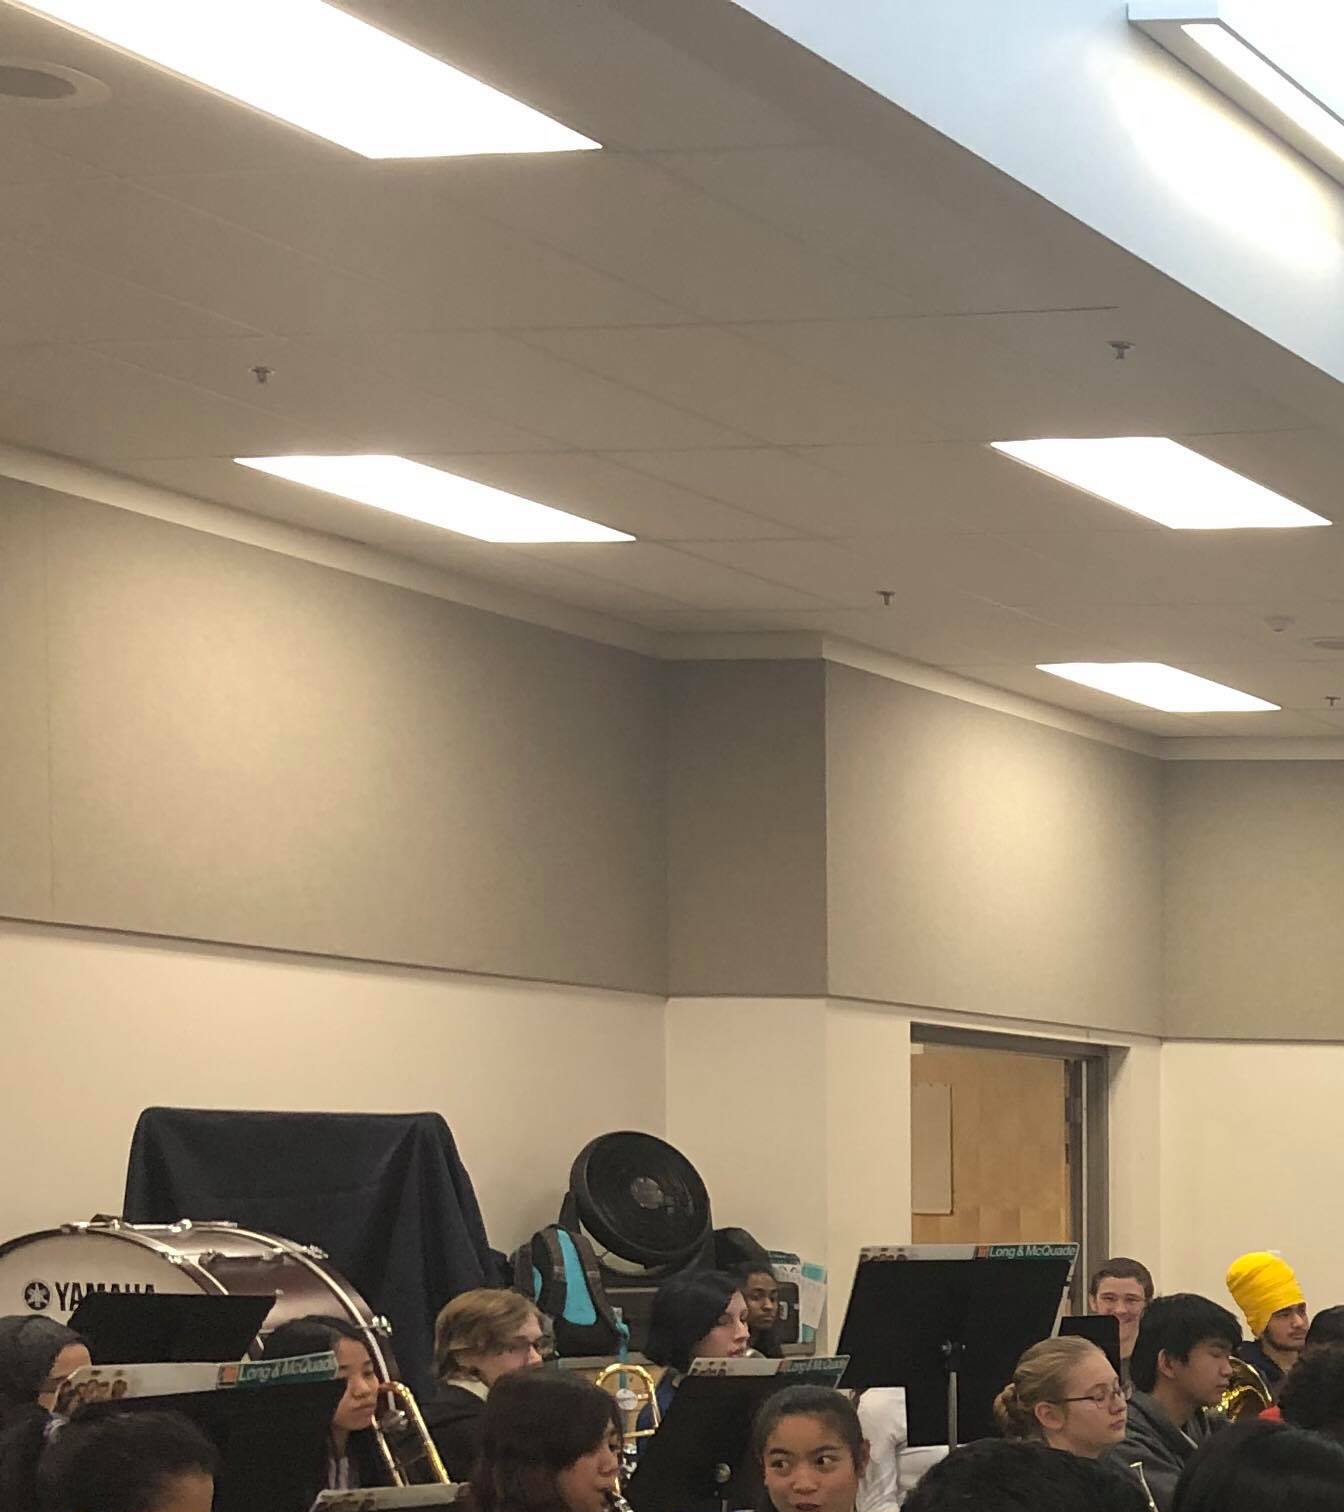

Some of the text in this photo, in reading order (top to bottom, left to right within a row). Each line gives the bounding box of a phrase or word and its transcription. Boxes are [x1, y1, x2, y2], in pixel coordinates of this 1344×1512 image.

[990, 1245, 1076, 1259] Long & McQuade
[240, 1364, 271, 1382] Long
